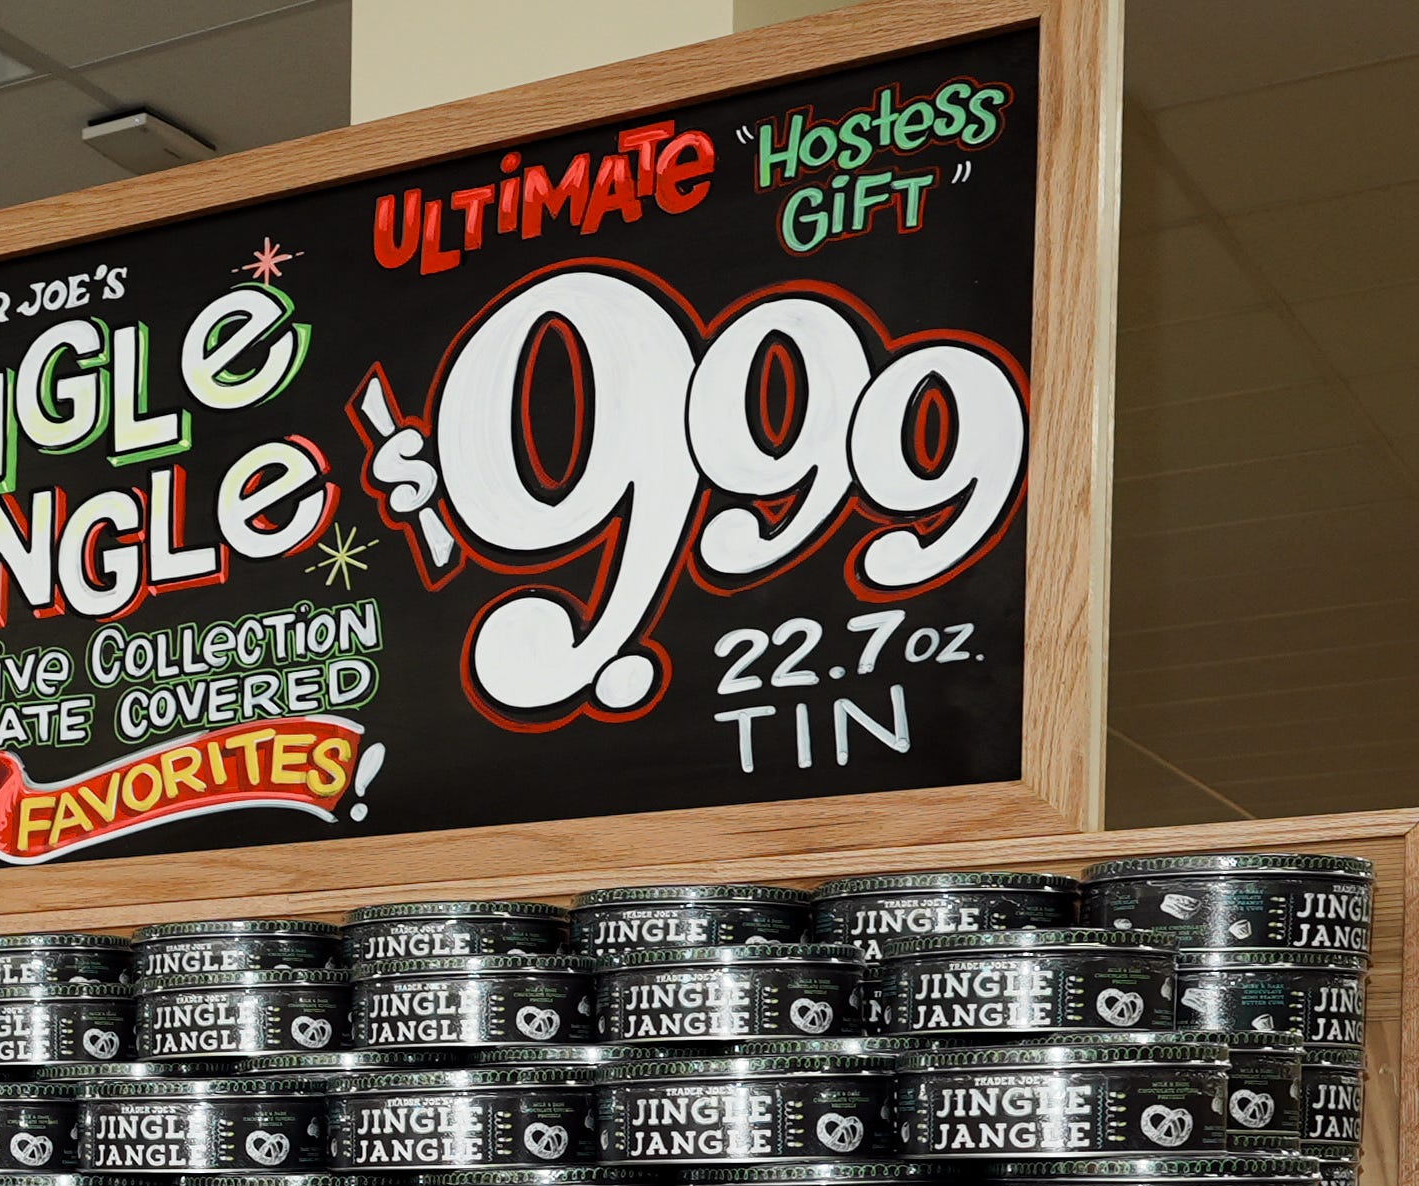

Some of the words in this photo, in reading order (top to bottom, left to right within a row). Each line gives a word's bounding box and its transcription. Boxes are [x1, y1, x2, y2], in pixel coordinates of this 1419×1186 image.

[16, 265, 128, 318] JOE'S
[715, 609, 905, 696] 22.7
[115, 659, 378, 743] COVERED
[715, 683, 910, 772] TIN
[594, 918, 707, 944] JINGLE
[856, 907, 979, 933] JINGLE
[915, 972, 1053, 1001] JINGLE
[913, 1002, 1052, 1029] JANGLE
[936, 1088, 1092, 1118] JINGLE
[935, 1121, 1090, 1150] JANGLE
